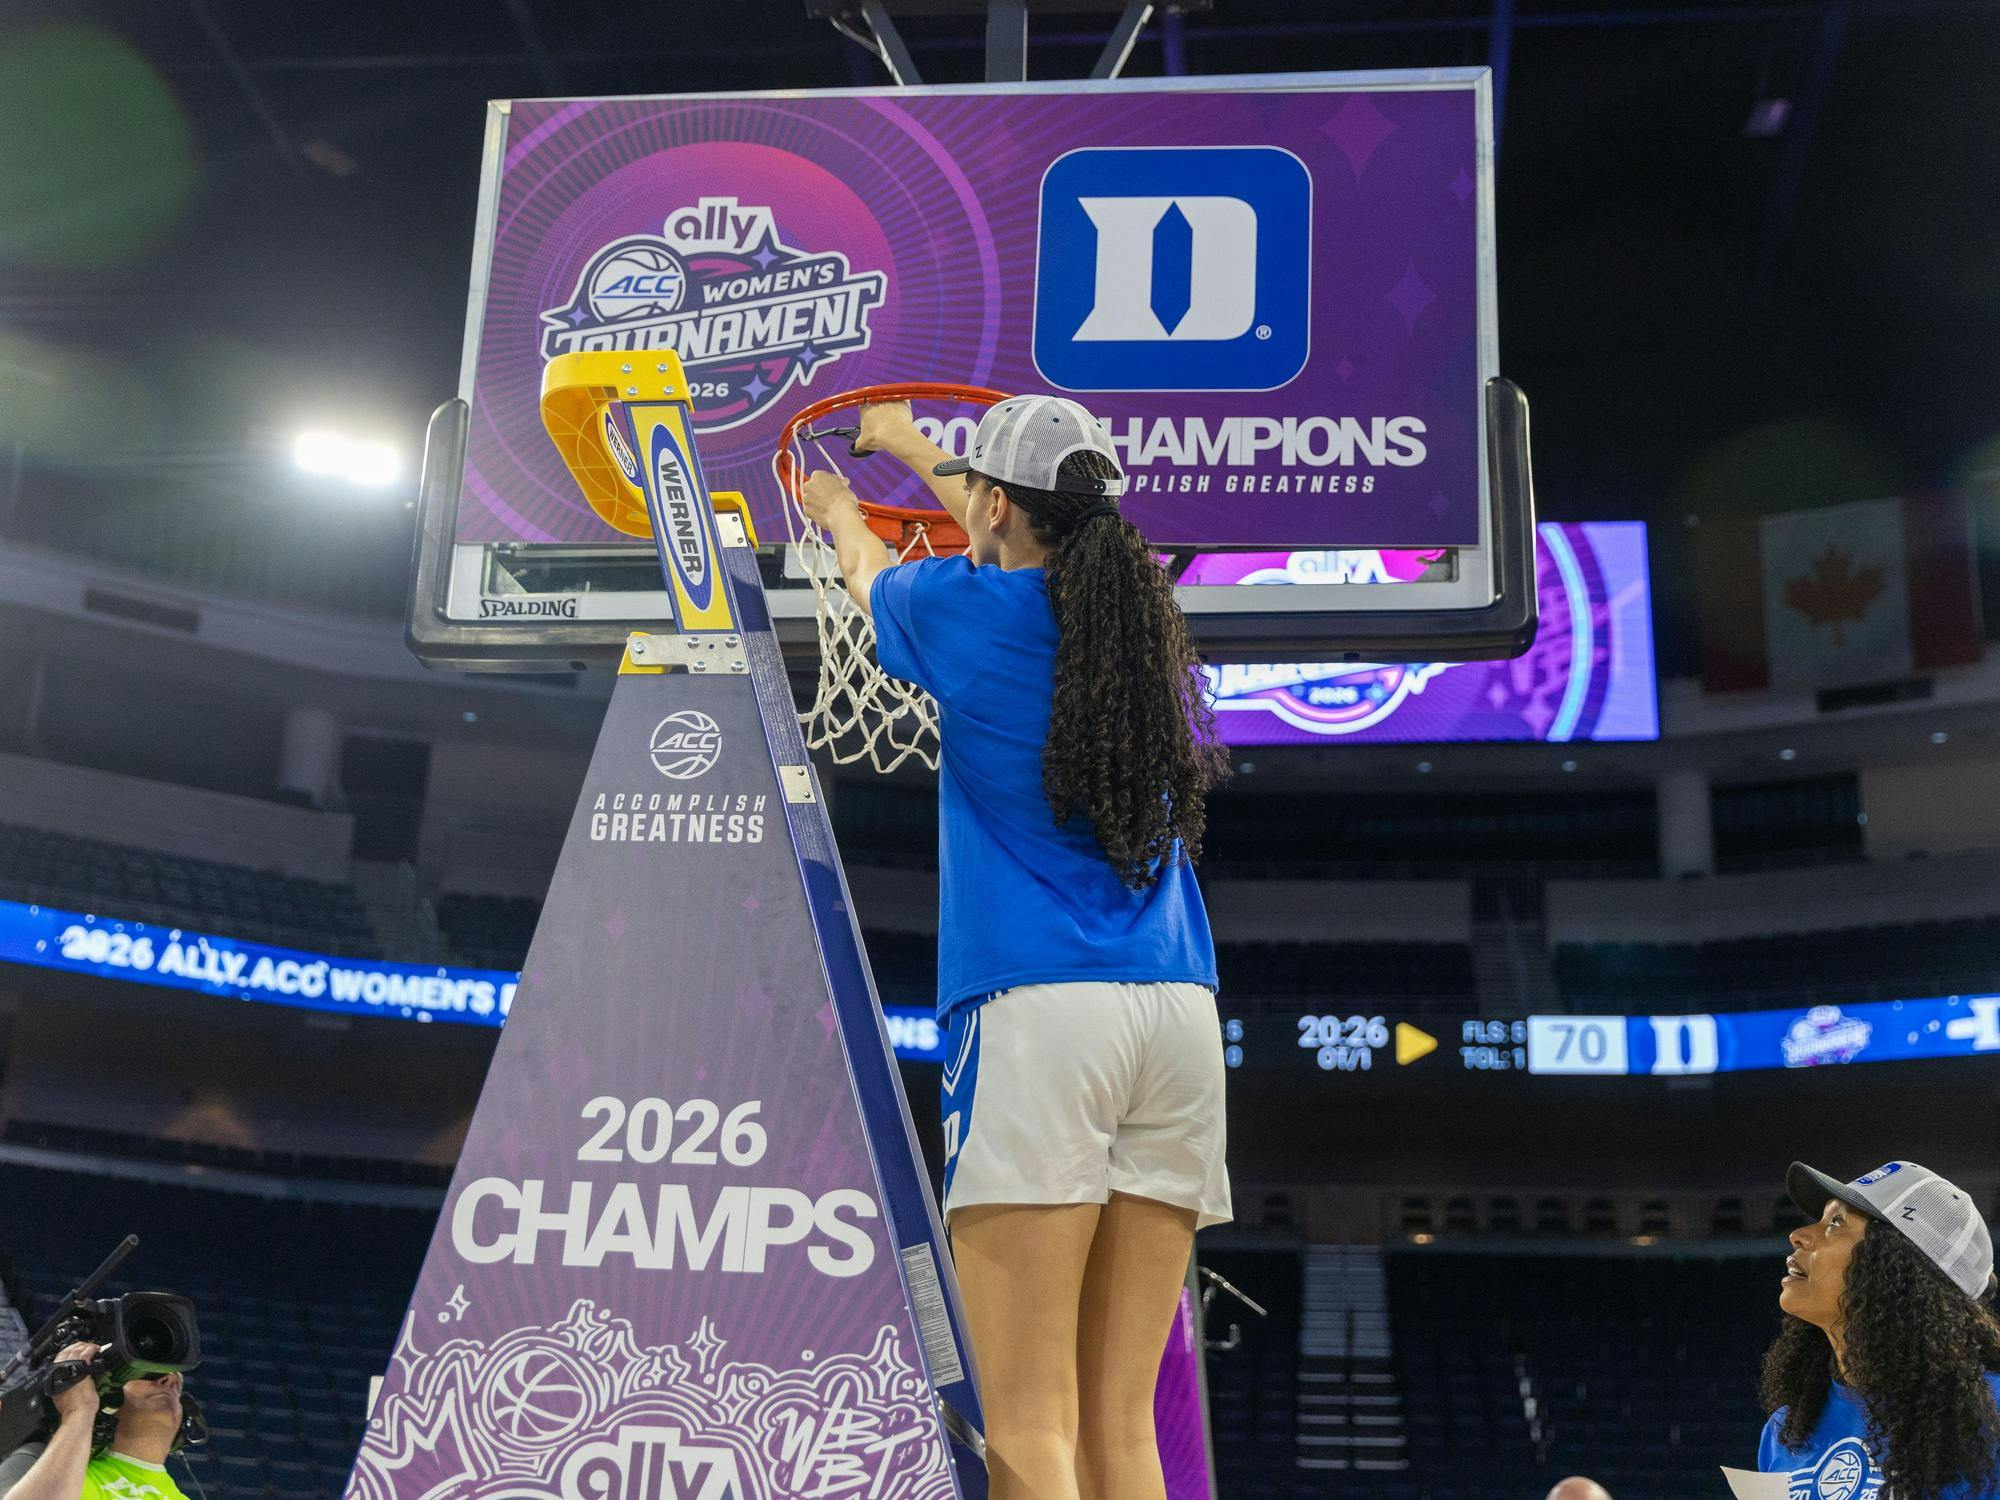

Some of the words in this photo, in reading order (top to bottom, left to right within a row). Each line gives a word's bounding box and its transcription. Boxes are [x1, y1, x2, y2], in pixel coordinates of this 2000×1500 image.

[674, 205, 758, 249] ally
[602, 274, 682, 294] ACC
[703, 262, 835, 304] WOMEN'S
[1071, 195, 1258, 342] D
[689, 382, 729, 398] 026
[608, 424, 634, 474] WERNER
[914, 416, 978, 459] 20
[1099, 416, 1427, 467] HAMPIONS
[1225, 474, 1376, 494] GREATNESS
[660, 461, 703, 574] WERNER
[479, 598, 577, 618] SPALDING
[657, 732, 721, 749] ACC
[594, 793, 767, 812] ACCOMPLISH
[590, 813, 765, 843] GREATNESS
[61, 925, 153, 970] 2026
[250, 956, 326, 997] ACC
[331, 971, 496, 1013] WOMEN'S
[1547, 1023, 1608, 1066] 70
[577, 1095, 768, 1167] 2026
[451, 1176, 879, 1278] CHAMPS
[576, 1441, 714, 1500] ally
[1825, 1468, 1860, 1481] ACC
